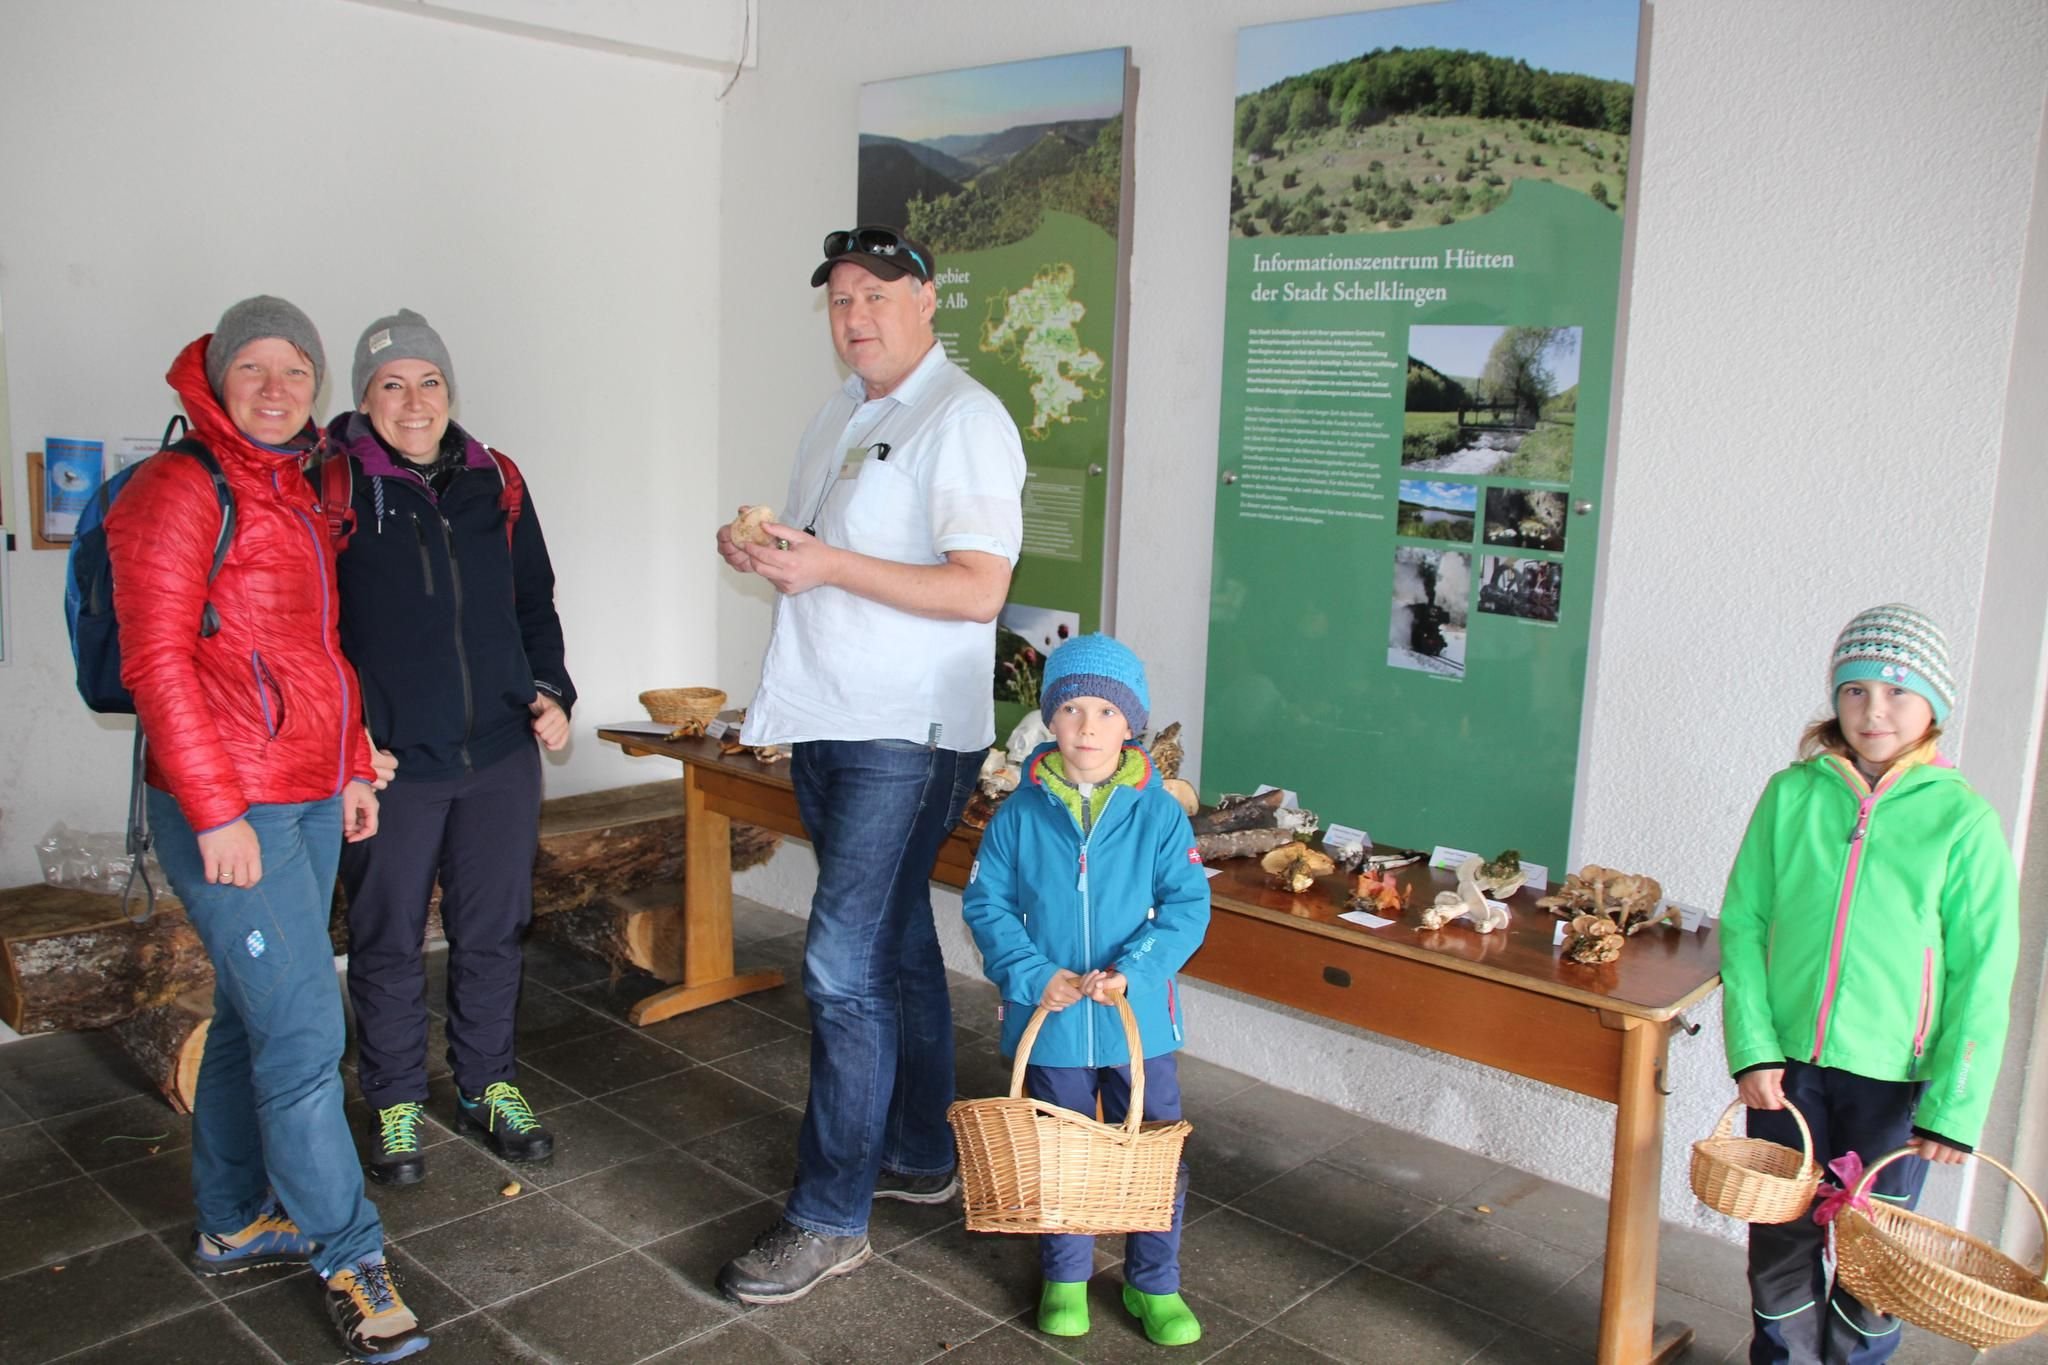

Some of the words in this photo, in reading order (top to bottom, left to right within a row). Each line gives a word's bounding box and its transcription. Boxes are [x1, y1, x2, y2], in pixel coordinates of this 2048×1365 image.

[1253, 251, 1439, 272] Informationszentrum
[1444, 248, 1515, 269] Hütten
[945, 292, 968, 309] Alb
[1251, 282, 1279, 301] der
[1282, 281, 1329, 301] Stadt
[1332, 280, 1447, 308] Schelklingen
